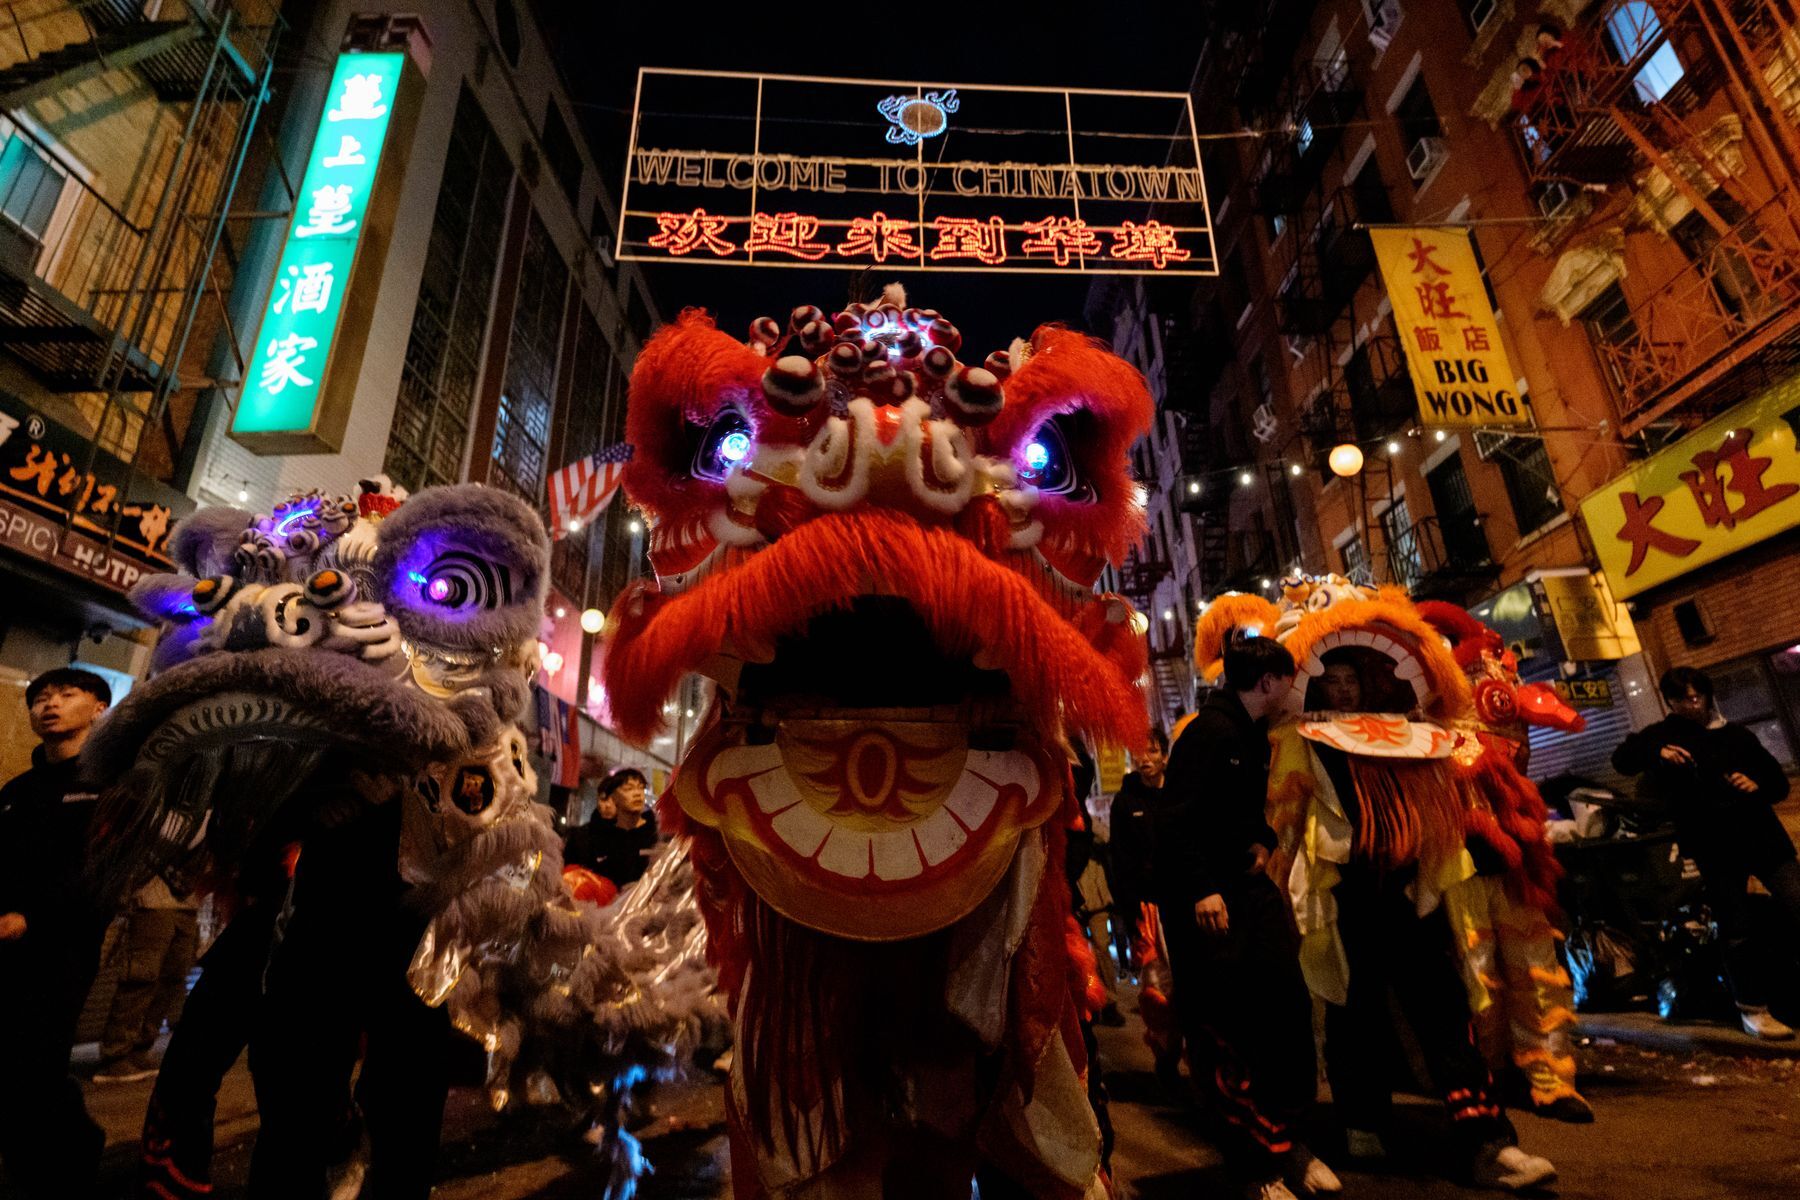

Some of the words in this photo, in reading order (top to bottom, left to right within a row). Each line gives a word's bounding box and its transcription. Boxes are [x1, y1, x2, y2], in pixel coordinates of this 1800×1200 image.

[635, 148, 847, 193] WELCOME
[876, 160, 927, 195] TO
[953, 161, 1201, 202] CHINATOWN
[1408, 237, 1472, 320] 大旺
[1433, 359, 1489, 384] BIG
[1425, 390, 1518, 417] WONG
[1616, 428, 1800, 578] 大旺
[72, 543, 145, 588] HOTP
